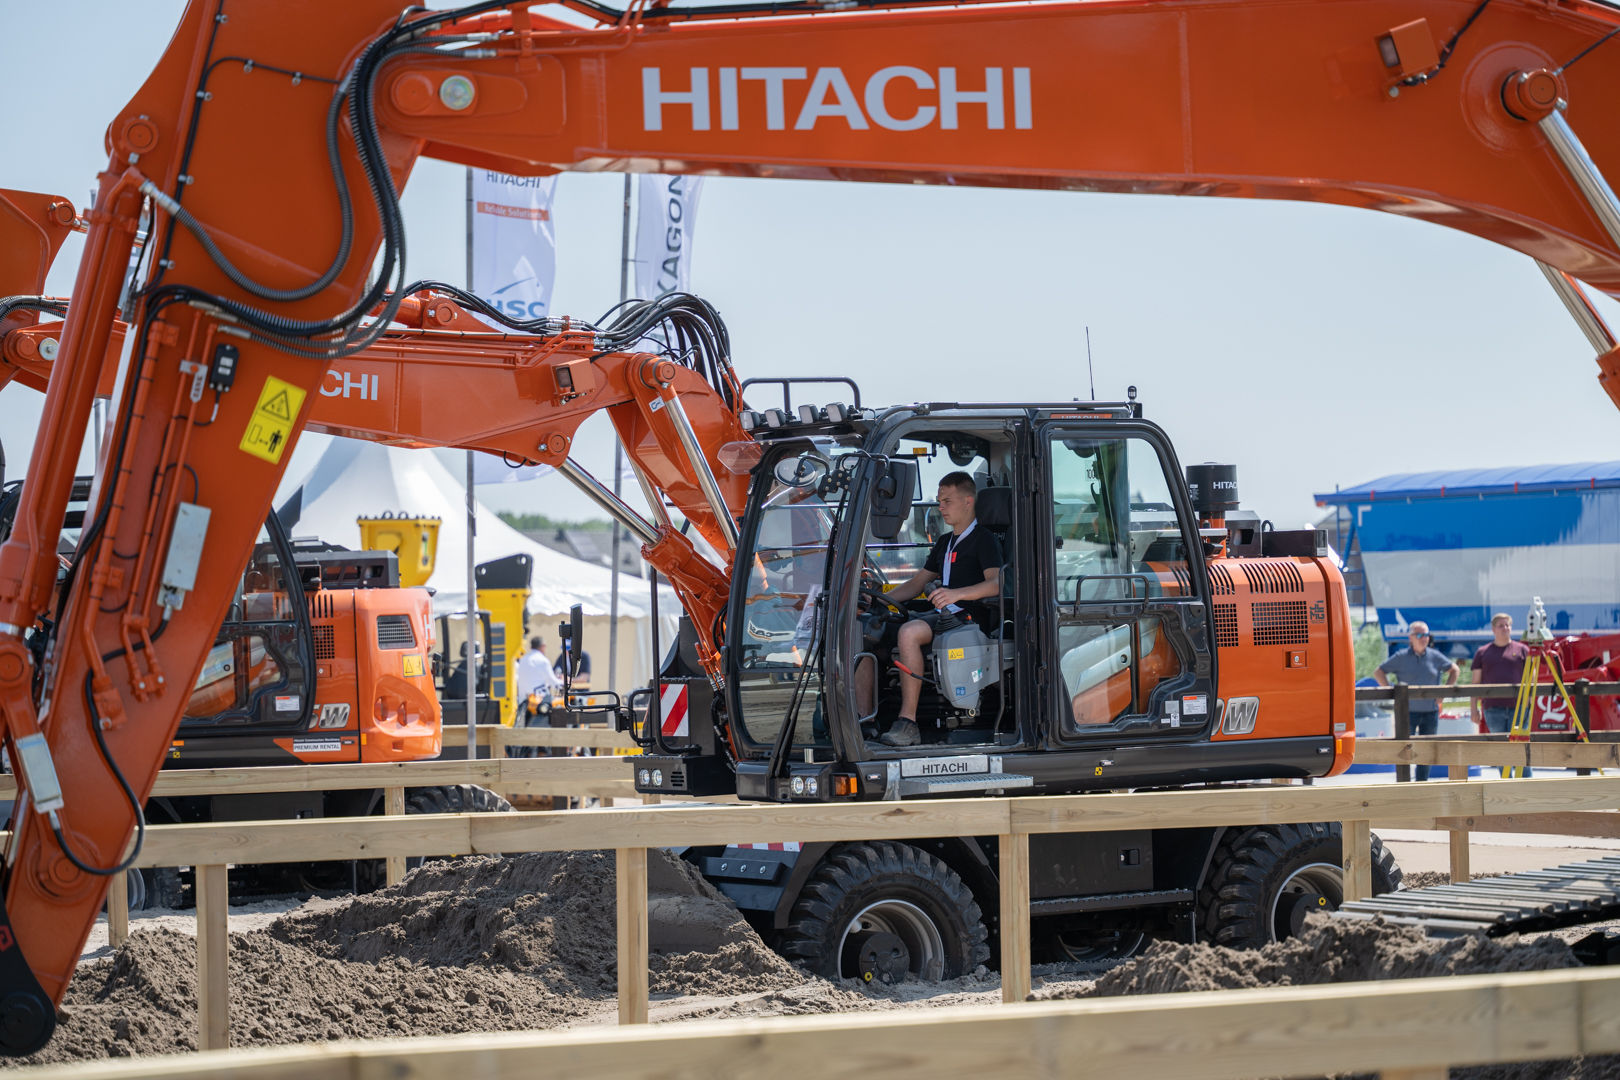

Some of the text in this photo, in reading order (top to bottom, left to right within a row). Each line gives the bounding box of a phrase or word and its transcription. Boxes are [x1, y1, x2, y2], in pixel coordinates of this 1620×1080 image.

[641, 65, 1033, 131] HITACHI
[486, 171, 541, 188] HITACHI
[319, 369, 379, 401] CHI
[1212, 481, 1237, 490] HITAC
[922, 762, 968, 774] HITACHI
